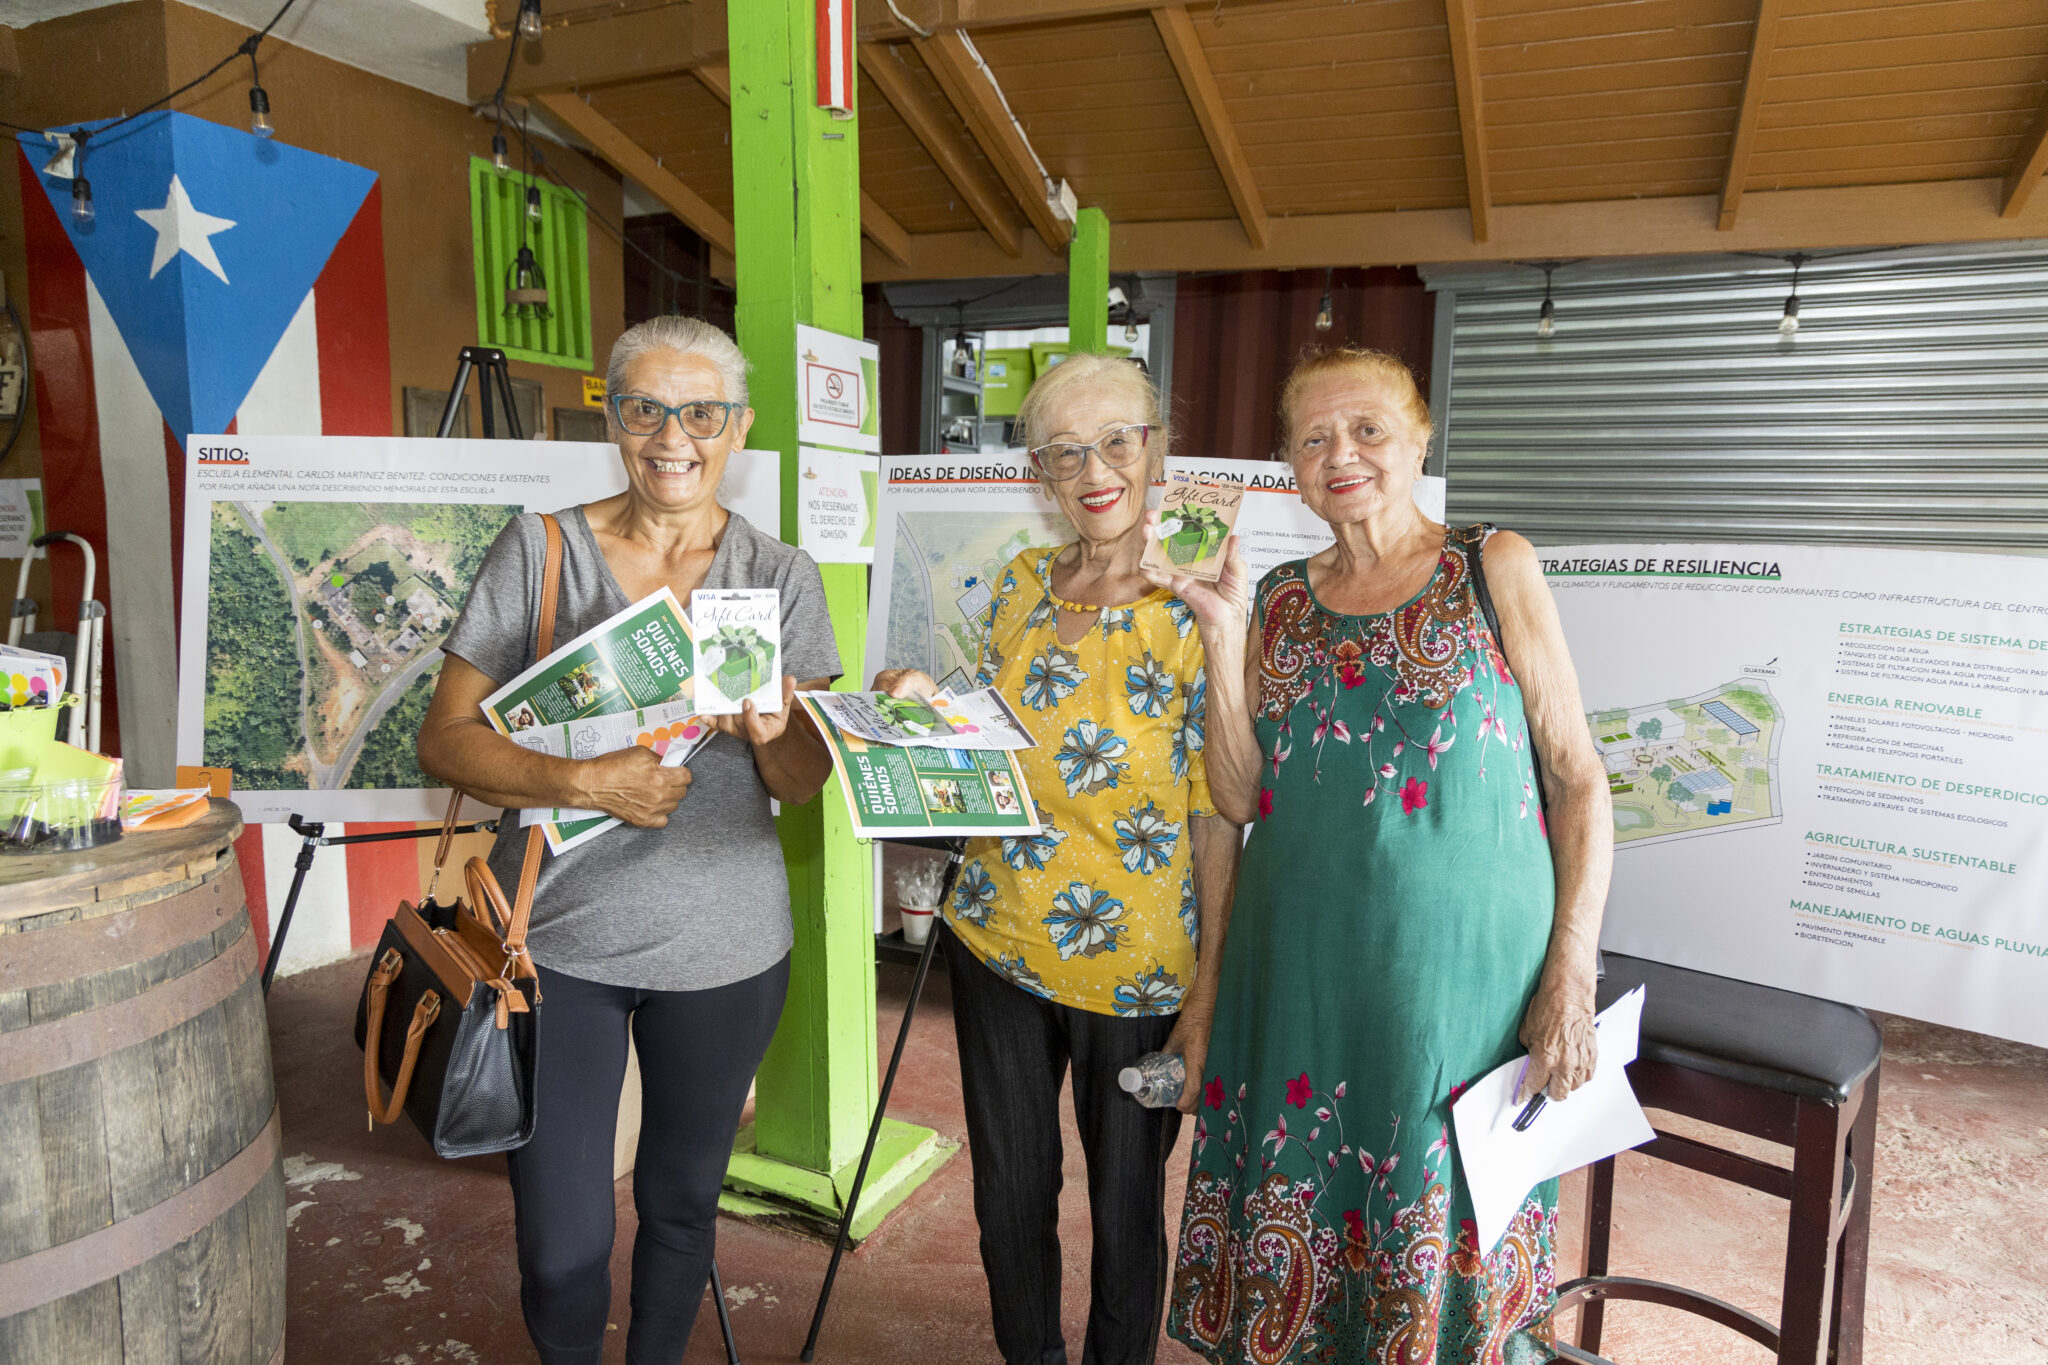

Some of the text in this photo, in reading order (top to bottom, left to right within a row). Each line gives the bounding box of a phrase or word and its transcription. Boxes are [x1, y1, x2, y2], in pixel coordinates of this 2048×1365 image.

[199, 447, 248, 461] SITIO:
[198, 470, 240, 478] ESCUELA
[242, 470, 294, 478] ELEMENTAL
[297, 470, 334, 478] CARLOS
[337, 471, 384, 480] MARTINEZ
[430, 473, 496, 482] CONDICIONES
[499, 475, 550, 483] EXISTENTES
[890, 468, 931, 480] IDEAS
[936, 467, 954, 480] DE
[960, 463, 1017, 479] DISEÑO
[1173, 475, 1189, 484] VISA
[248, 482, 275, 491] AÑADA
[441, 486, 458, 494] ESTA
[925, 486, 949, 494] AÑADA
[1164, 488, 1240, 508] Gift Card
[808, 500, 858, 512] NOS RESERVAMOS
[811, 514, 856, 525] EL DERECHO DE
[1539, 559, 1781, 576] TRATEGIAS DE RESILIENCIA
[1608, 582, 1670, 590] FUNDAMENTOS
[1685, 583, 1740, 592] REDUCCION
[1756, 586, 1840, 598] CONTAMINANTES
[1842, 590, 1876, 600] COMO
[1879, 593, 1980, 608] INFRAESTRUCTURA
[1983, 601, 2003, 611] DEL
[1840, 623, 1932, 640] ESTRATEGIAS
[1937, 631, 1956, 642] DE
[1961, 633, 2023, 648] SISTEMA
[2028, 639, 2048, 650] DE
[1846, 642, 1895, 651] RECOLECCION
[630, 628, 670, 678] SOMOS
[646, 620, 690, 678] QUIÉNES
[1842, 660, 1874, 668] SISTEMAS
[1888, 664, 1929, 673] FILTRACION
[1977, 674, 2010, 682] POTABLE
[1844, 651, 1876, 659] TANQUES
[1912, 657, 1949, 666] ELEVADOS
[1973, 664, 2028, 674] DISTRIBUCION
[1882, 672, 1924, 682] FILTRACION
[1983, 684, 2029, 694] IRRIGACION
[1828, 692, 1889, 708] ENERGIA
[1894, 699, 1983, 719] RENOVABLE
[1834, 724, 1866, 733] BATERIAS
[1836, 714, 2014, 742] PANELES SOLARES FOTOVOLTAICOS MICROGRID
[1833, 733, 1889, 746] REFRIGERACION
[1903, 742, 1944, 752] MEDICINAS
[1831, 742, 1864, 751] RECARGA
[1878, 748, 1918, 758] TELEFONOS
[1921, 753, 1963, 765] PORTATILES
[857, 756, 886, 814] QUIÉNES
[878, 766, 899, 814] SOMOS
[1816, 764, 1917, 786] TRATAMIENTO
[1921, 778, 1941, 790] DE
[1945, 782, 2048, 805] DESPERDICIO
[1824, 785, 1864, 796] RETENCION
[1878, 792, 1924, 805] SEDIMENTOS
[1822, 794, 1871, 806] TRATAMIENTO
[1872, 801, 1904, 812] ATRAVES
[1920, 809, 1955, 820] SISTEMAS
[1957, 815, 2008, 827] ECOLOGICOS
[1804, 830, 1907, 856] AGRICULTURA
[1912, 848, 2016, 874] SUSTENTABLE
[1812, 852, 1838, 861] JARDIN
[1839, 856, 1892, 870] COMUNITARIO
[1809, 870, 1873, 887] ENTRENAMIENTOS
[1810, 861, 1862, 875] INVERNADERO
[1870, 872, 1900, 881] SISTEMA
[1902, 877, 1958, 892] HIDROPONICO
[1807, 880, 1834, 889] BANCO
[1846, 887, 1880, 898] SEMILLAS
[1790, 899, 1906, 930] MANEJAMIENTO
[1911, 922, 1931, 935] DE
[1935, 928, 1990, 946] AGUAS
[1801, 922, 1842, 937] PAVIMENTO
[1844, 931, 1886, 944] PERMEABLE
[1800, 932, 1853, 947] BIORETENCION
